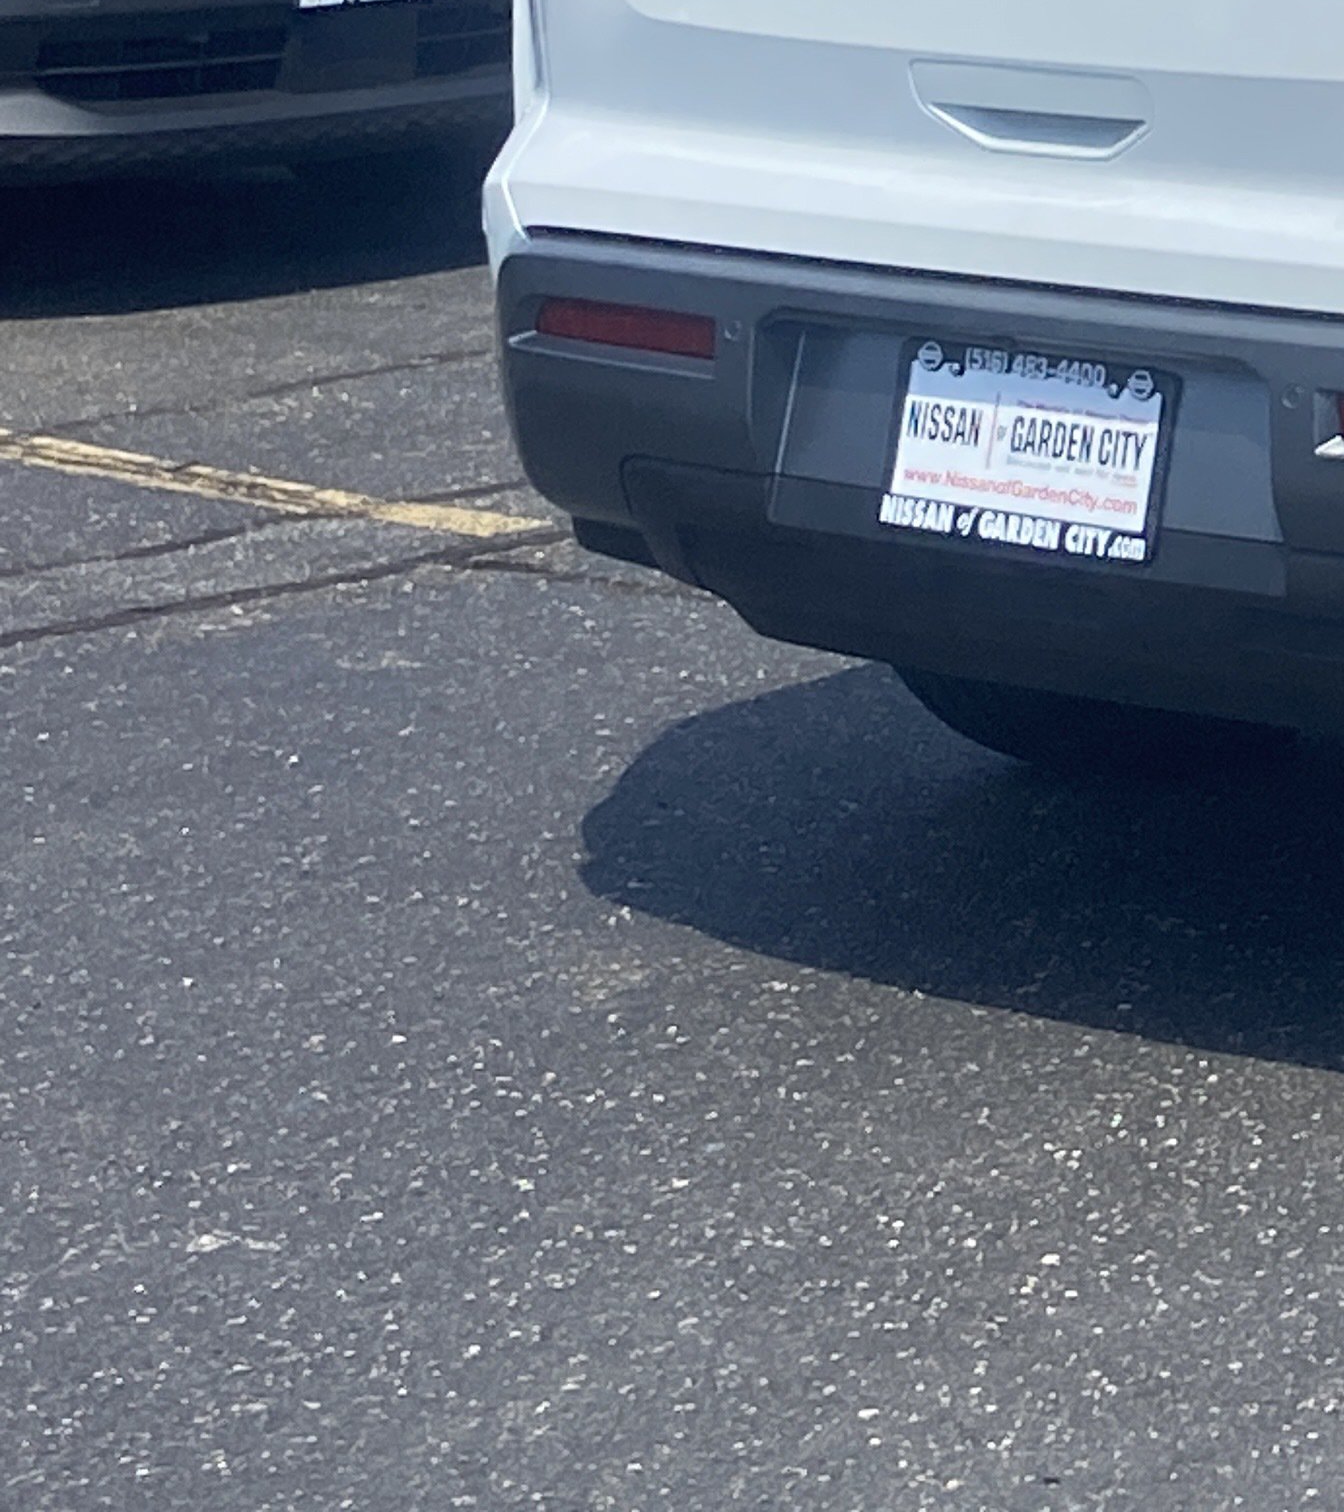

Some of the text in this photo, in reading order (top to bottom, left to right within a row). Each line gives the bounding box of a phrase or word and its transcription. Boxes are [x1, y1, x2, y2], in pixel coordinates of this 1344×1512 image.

[965, 347, 1009, 374] (516)
[906, 399, 983, 448] NISSAN
[1010, 416, 1095, 463] GARDEN
[1098, 428, 1148, 470] CITY
[879, 494, 955, 534] NISSAN
[956, 507, 978, 536] of
[978, 510, 1062, 551] GARDEN
